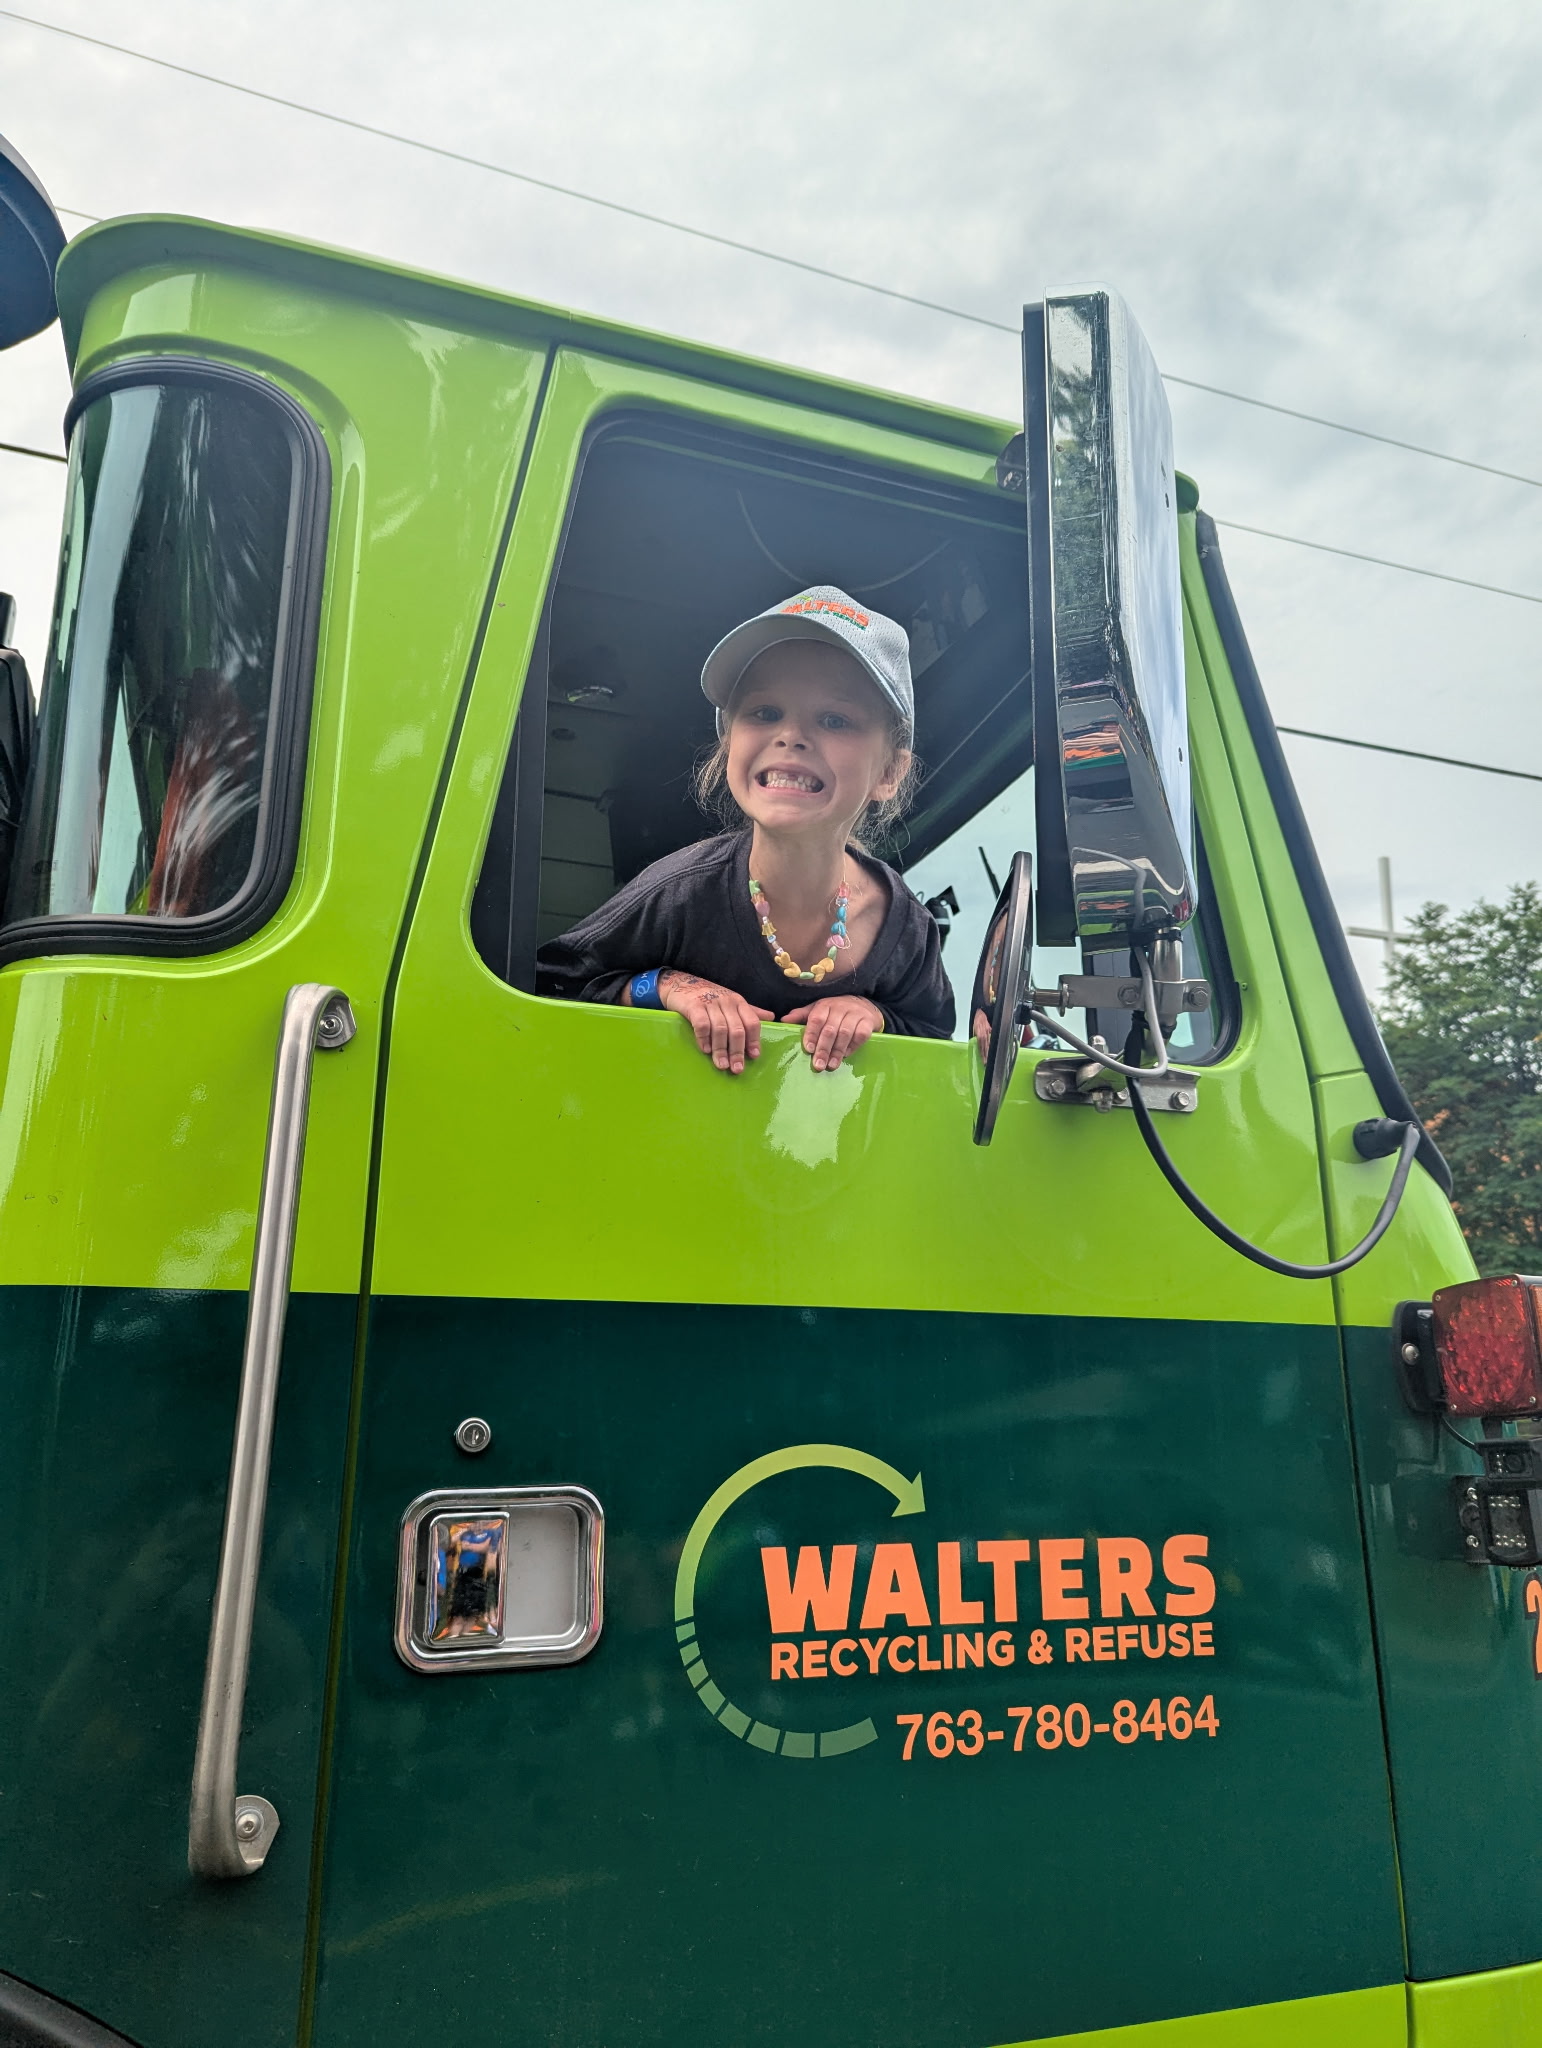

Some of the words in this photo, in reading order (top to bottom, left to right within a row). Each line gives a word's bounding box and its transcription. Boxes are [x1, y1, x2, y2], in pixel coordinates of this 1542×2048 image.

[761, 1534, 1216, 1634] WALTERS
[771, 1630, 1015, 1680] RECYCLING
[1028, 1629, 1053, 1665] &
[1065, 1622, 1215, 1663] REFUSE
[896, 1695, 1220, 1760] 763-780-8464
